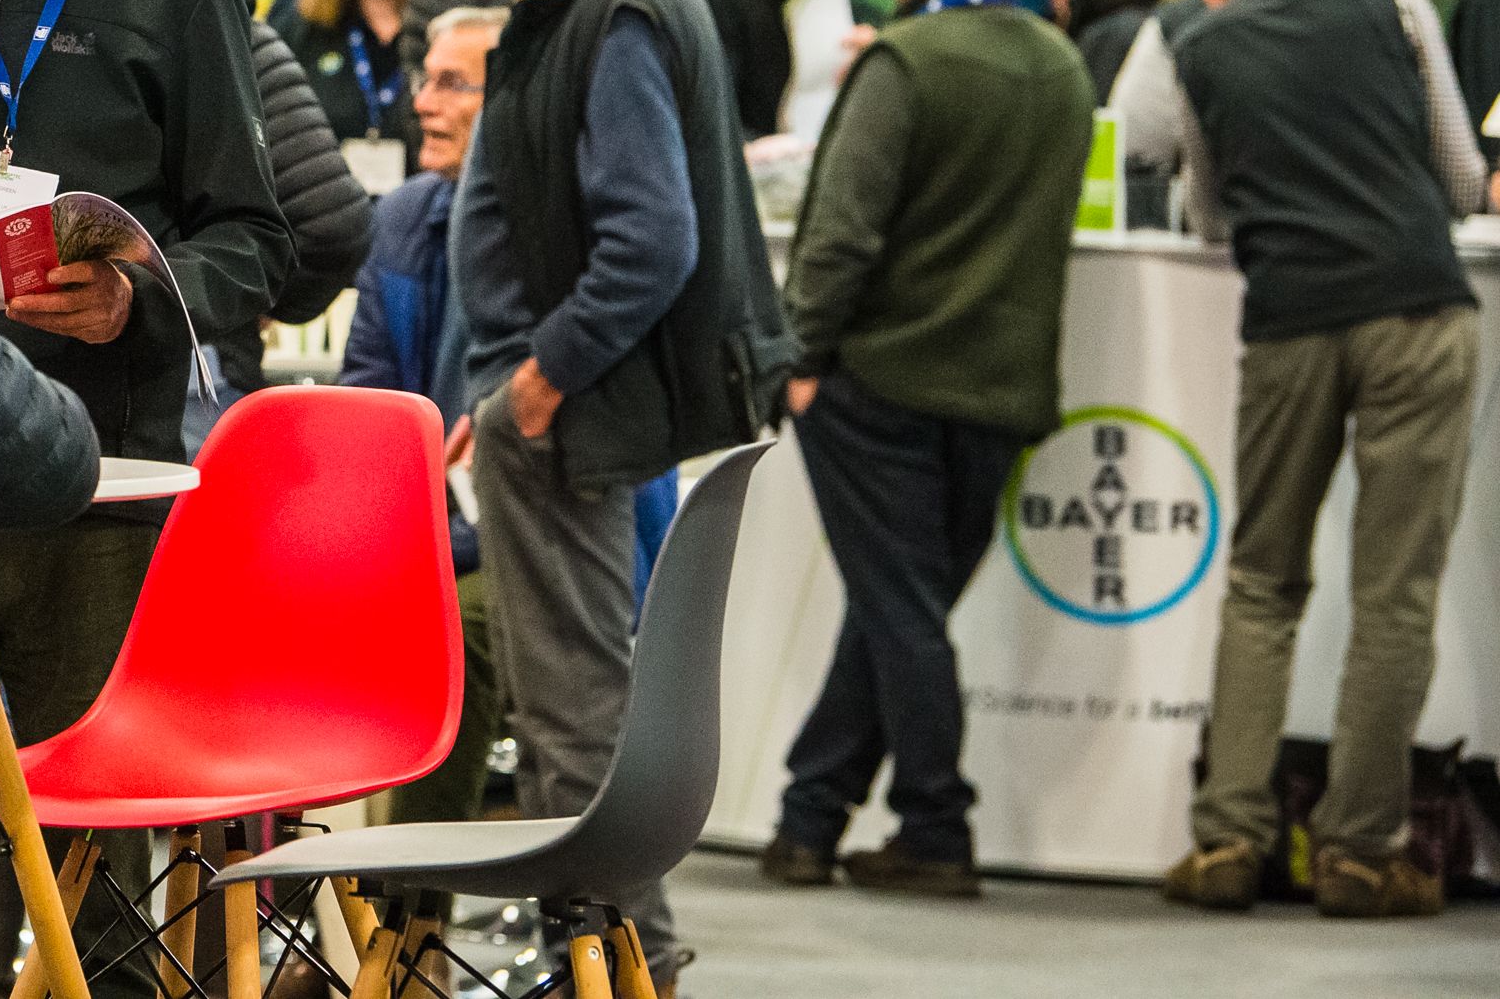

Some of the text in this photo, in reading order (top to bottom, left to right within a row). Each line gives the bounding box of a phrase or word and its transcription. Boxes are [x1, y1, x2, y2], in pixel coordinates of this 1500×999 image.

[52, 32, 77, 43] Jack
[1021, 493, 1199, 534] BAYER
[1090, 425, 1127, 608] BAYER
